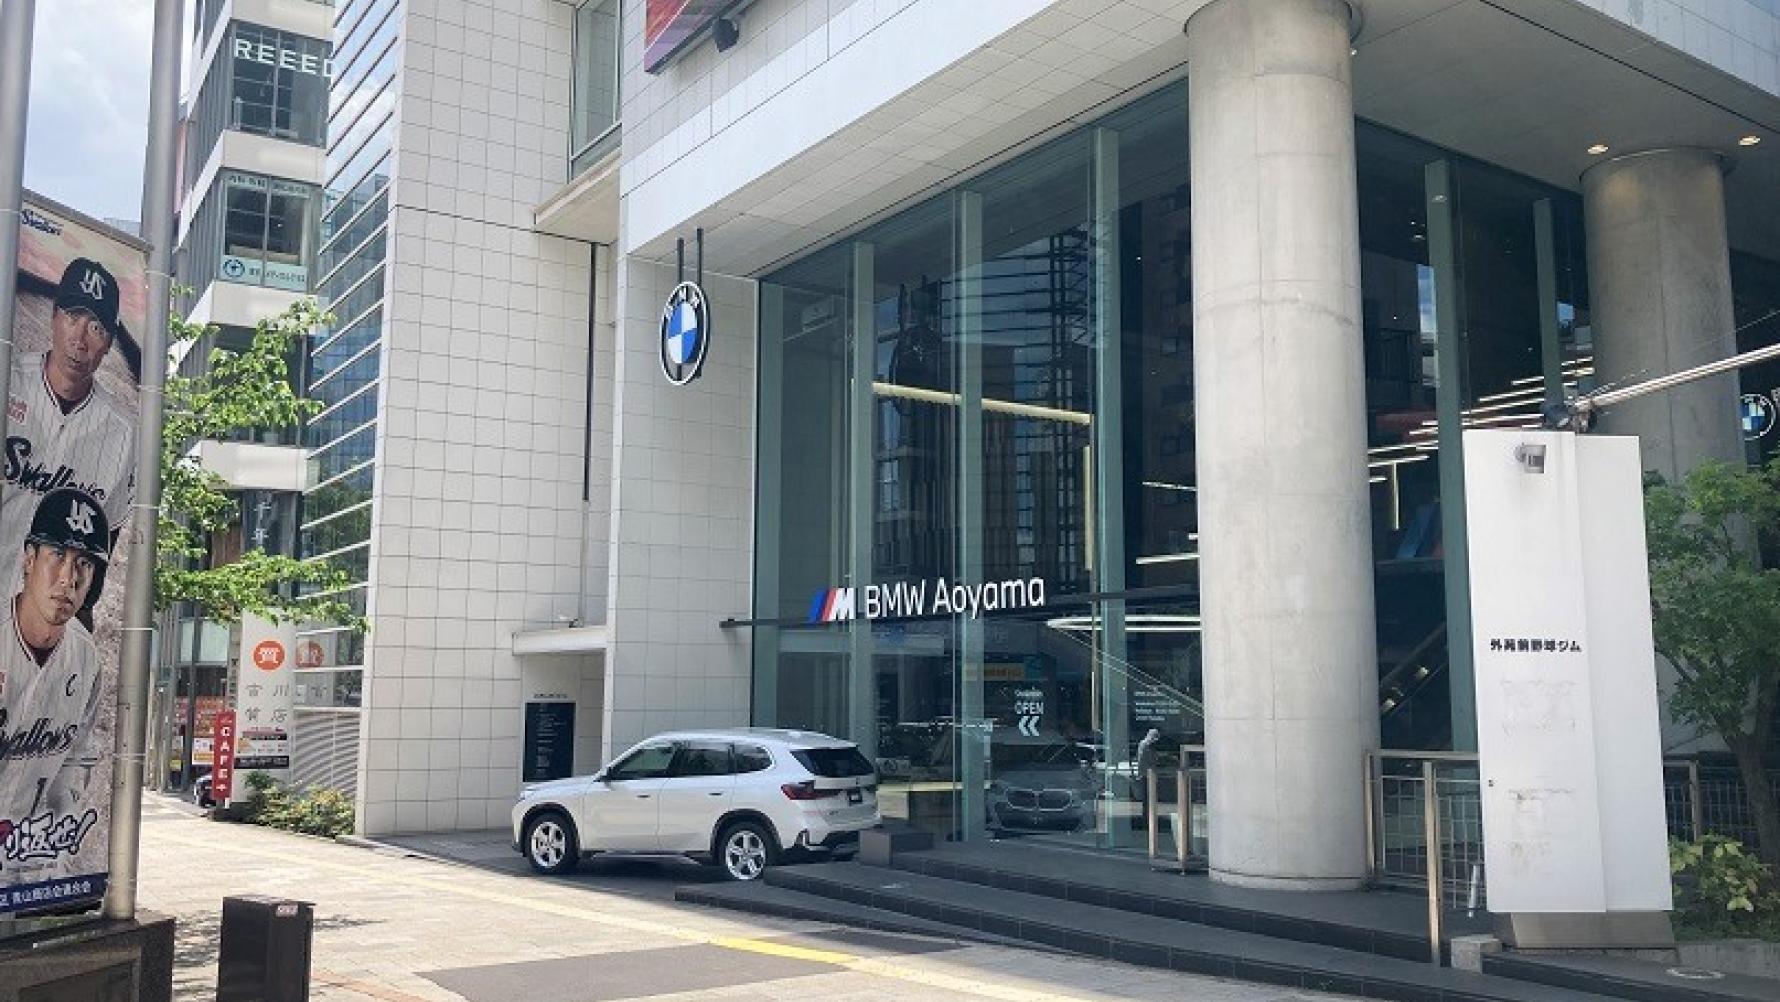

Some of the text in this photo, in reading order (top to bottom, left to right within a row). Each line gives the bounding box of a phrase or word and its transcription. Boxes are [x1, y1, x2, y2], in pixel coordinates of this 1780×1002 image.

[6, 436, 107, 501] Swalls
[864, 579, 926, 619] BMW
[933, 577, 1044, 619] Aoyama
[1014, 701, 1044, 715] OPEN
